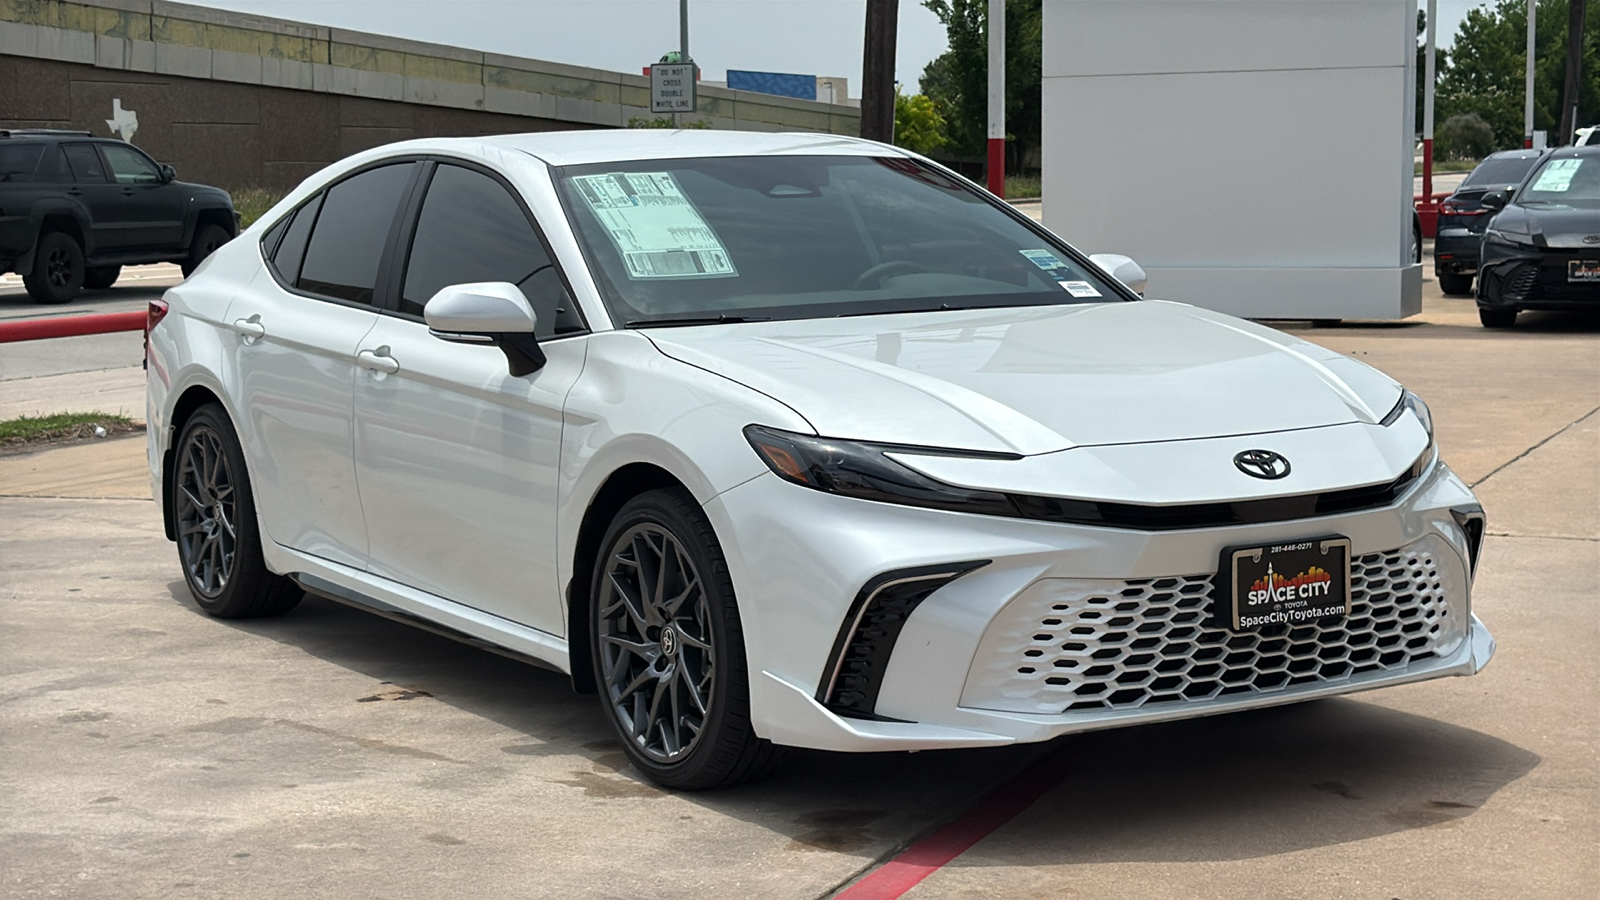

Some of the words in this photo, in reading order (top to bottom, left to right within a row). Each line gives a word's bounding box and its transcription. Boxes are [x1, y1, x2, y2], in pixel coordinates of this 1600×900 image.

[1247, 580, 1296, 606] SPACE
[1298, 581, 1331, 598] CITY
[1240, 605, 1345, 628] SpaceCityToyota.com
[1284, 600, 1309, 610] TOYOTA
